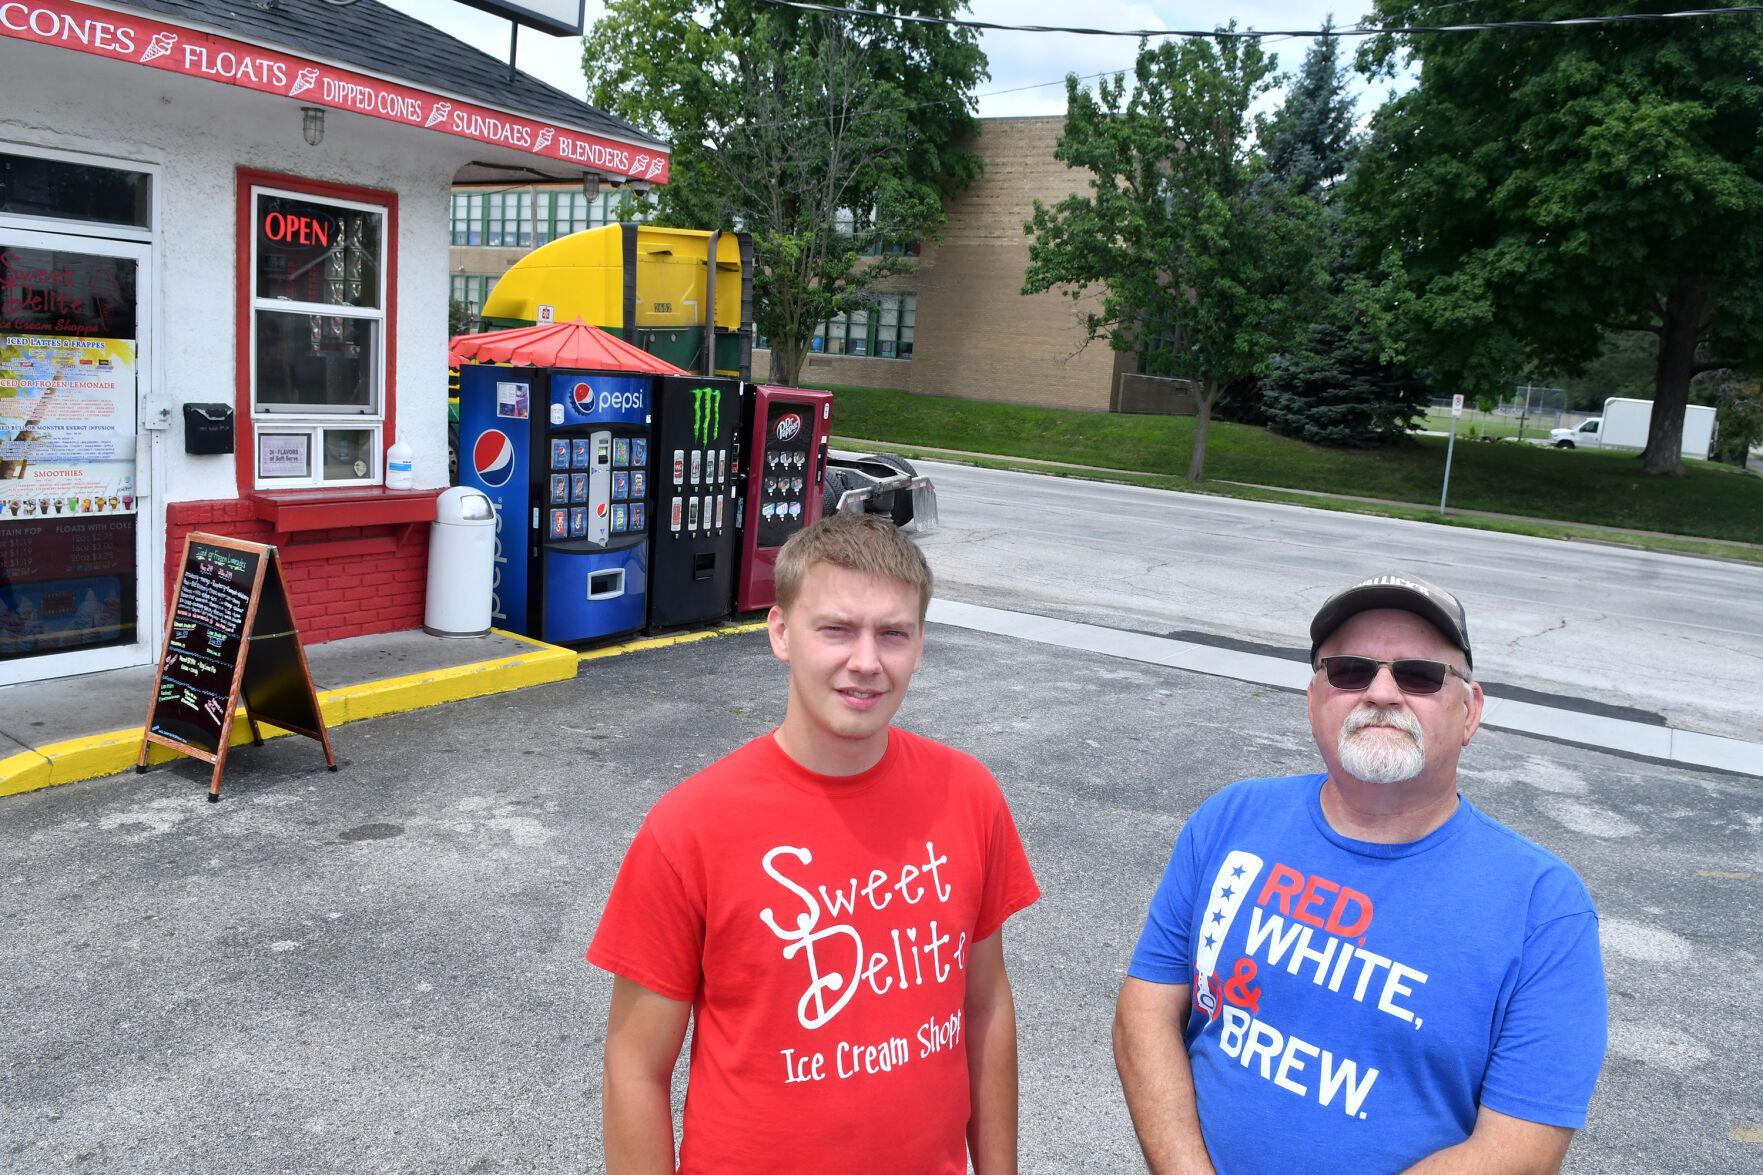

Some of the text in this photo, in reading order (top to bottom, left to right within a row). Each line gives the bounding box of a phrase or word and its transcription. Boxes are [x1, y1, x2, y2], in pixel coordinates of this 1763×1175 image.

[0, 3, 135, 53] CONES
[183, 44, 286, 86] FLOATS
[323, 78, 422, 122] DIPPED CONES
[454, 111, 531, 148] SUNDAES
[559, 137, 629, 170] BLENDERS
[265, 212, 328, 248] OPEN
[0, 252, 74, 288] Sweet
[2, 282, 83, 314] Delite
[0, 316, 98, 336] ce Cream Shoppe
[598, 389, 643, 412] pepsi
[780, 420, 798, 440] Pepper
[786, 417, 794, 428] Dr
[760, 841, 951, 940] Sweet
[1257, 862, 1374, 948] RED,
[783, 912, 966, 1030] Delite
[1224, 958, 1262, 1014] &
[1245, 906, 1428, 1030] WHITE,
[780, 1048, 826, 1084] Ice
[836, 1036, 909, 1080] Cream
[1220, 1004, 1380, 1120] BREW.
